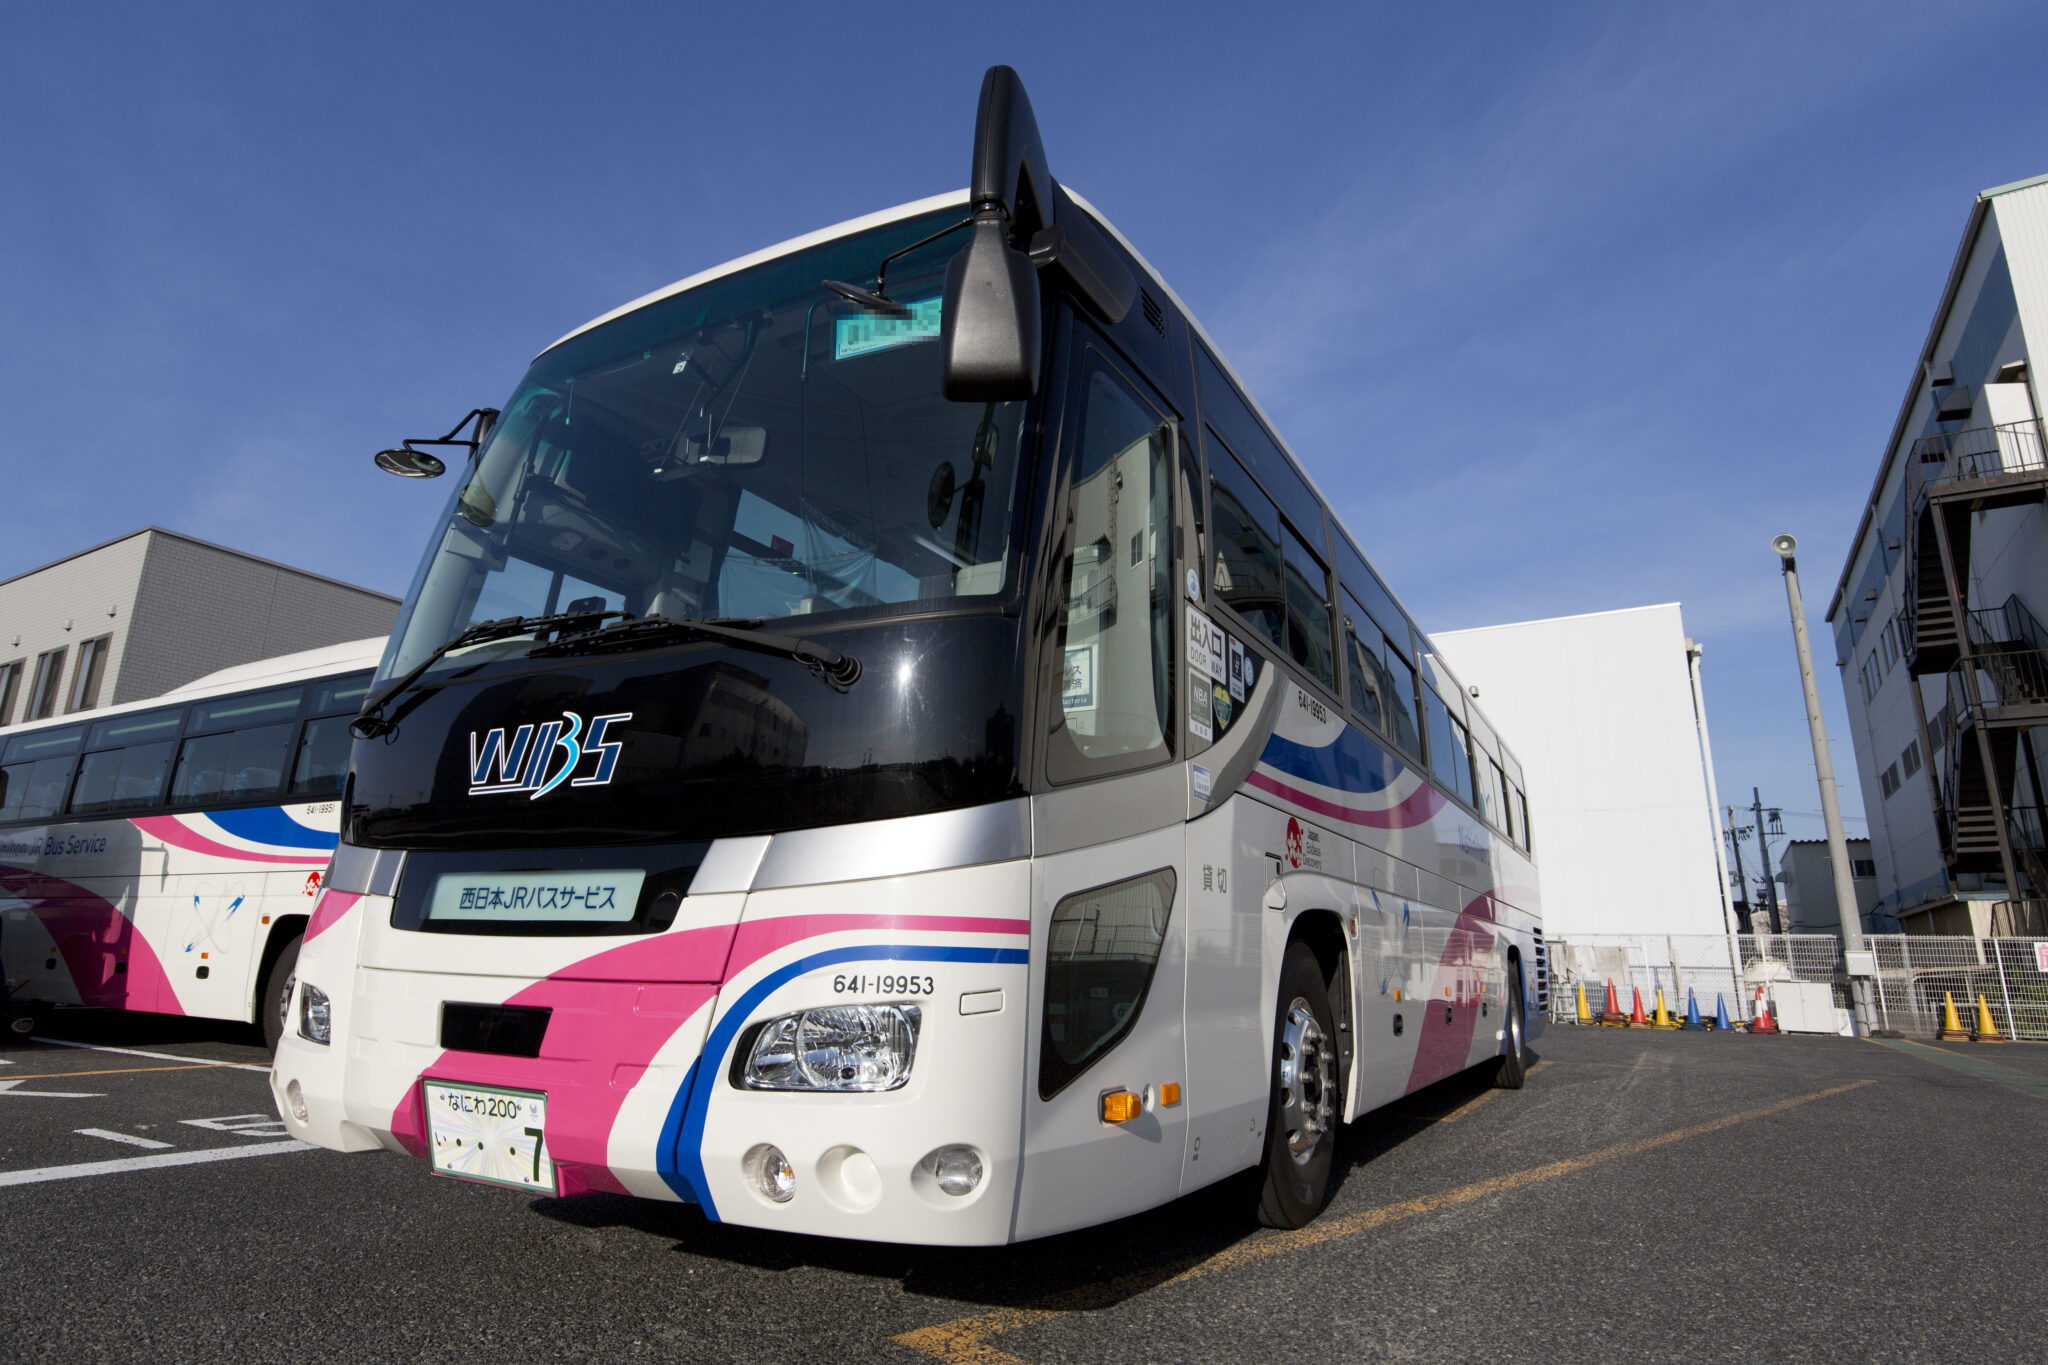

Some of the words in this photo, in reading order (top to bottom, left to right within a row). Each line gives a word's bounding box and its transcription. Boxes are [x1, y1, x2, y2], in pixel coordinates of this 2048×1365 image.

[1190, 613, 1222, 661] 出入口
[1190, 646, 1207, 668] DOOR
[1194, 685, 1208, 706] NBA
[44, 836, 65, 856] Bus
[66, 833, 107, 855] Service
[459, 886, 616, 910] 西日本JRバスサービス
[833, 974, 935, 995] 641-19953
